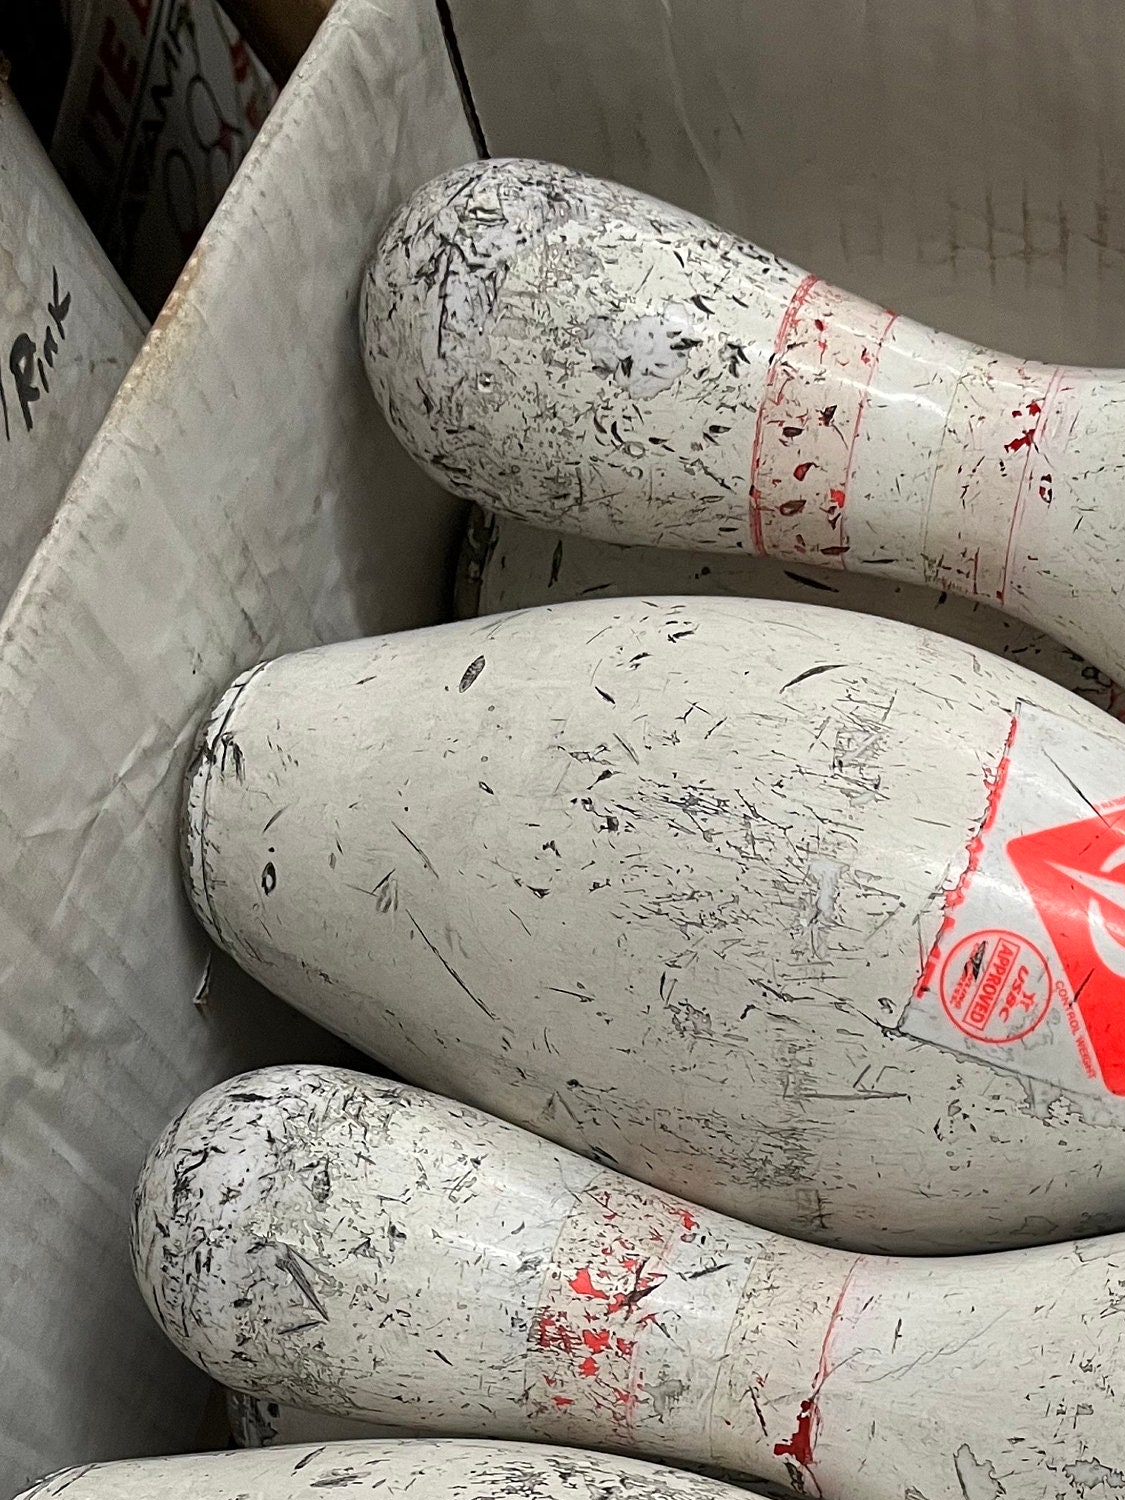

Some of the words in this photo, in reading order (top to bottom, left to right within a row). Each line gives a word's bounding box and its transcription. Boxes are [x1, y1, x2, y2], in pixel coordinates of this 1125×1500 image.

[970, 944, 1014, 1023] APPROVED
[999, 965, 1029, 1023] USBC
[1055, 981, 1080, 1035] CONTROL
[1076, 1035, 1096, 1079] WEIGHT
